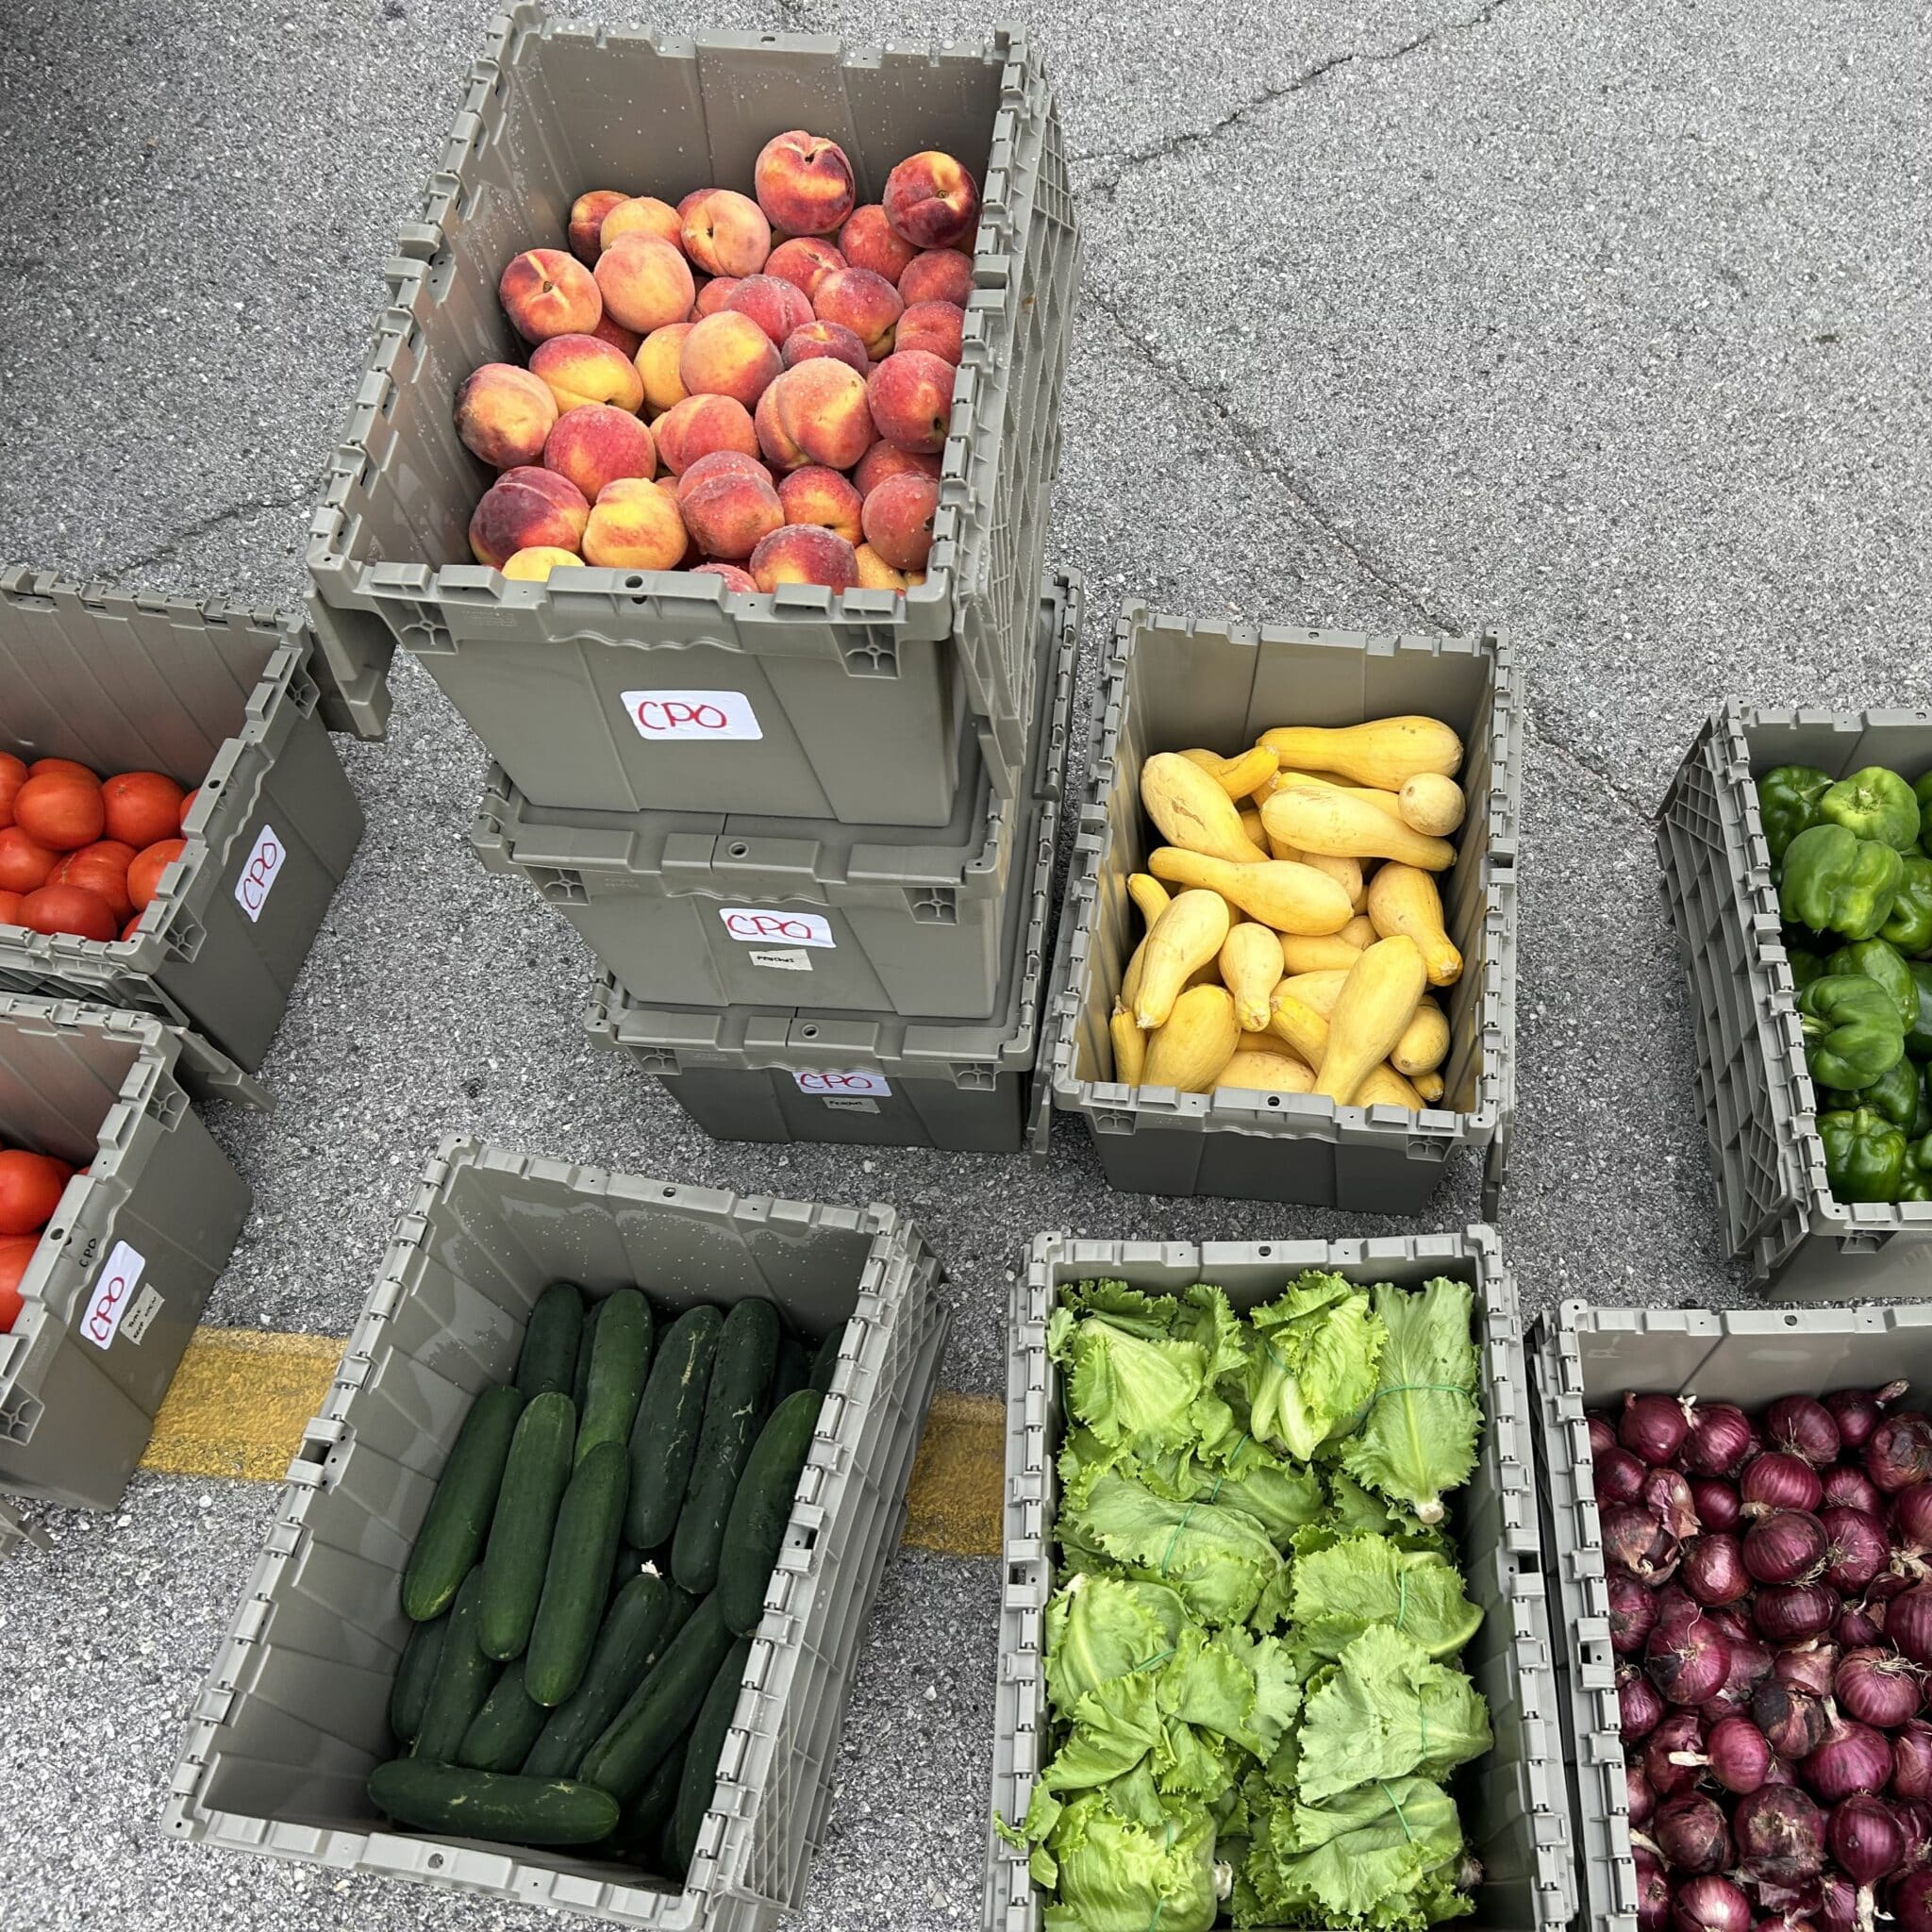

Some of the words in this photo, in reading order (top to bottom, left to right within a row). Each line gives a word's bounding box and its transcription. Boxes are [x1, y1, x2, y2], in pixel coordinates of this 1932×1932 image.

[638, 701, 727, 730] CPO
[243, 842, 277, 910] CPO
[727, 915, 812, 940] CPO
[800, 1073, 873, 1089] CPO
[78, 1238, 97, 1268] CPO
[90, 1276, 125, 1341] CPO
